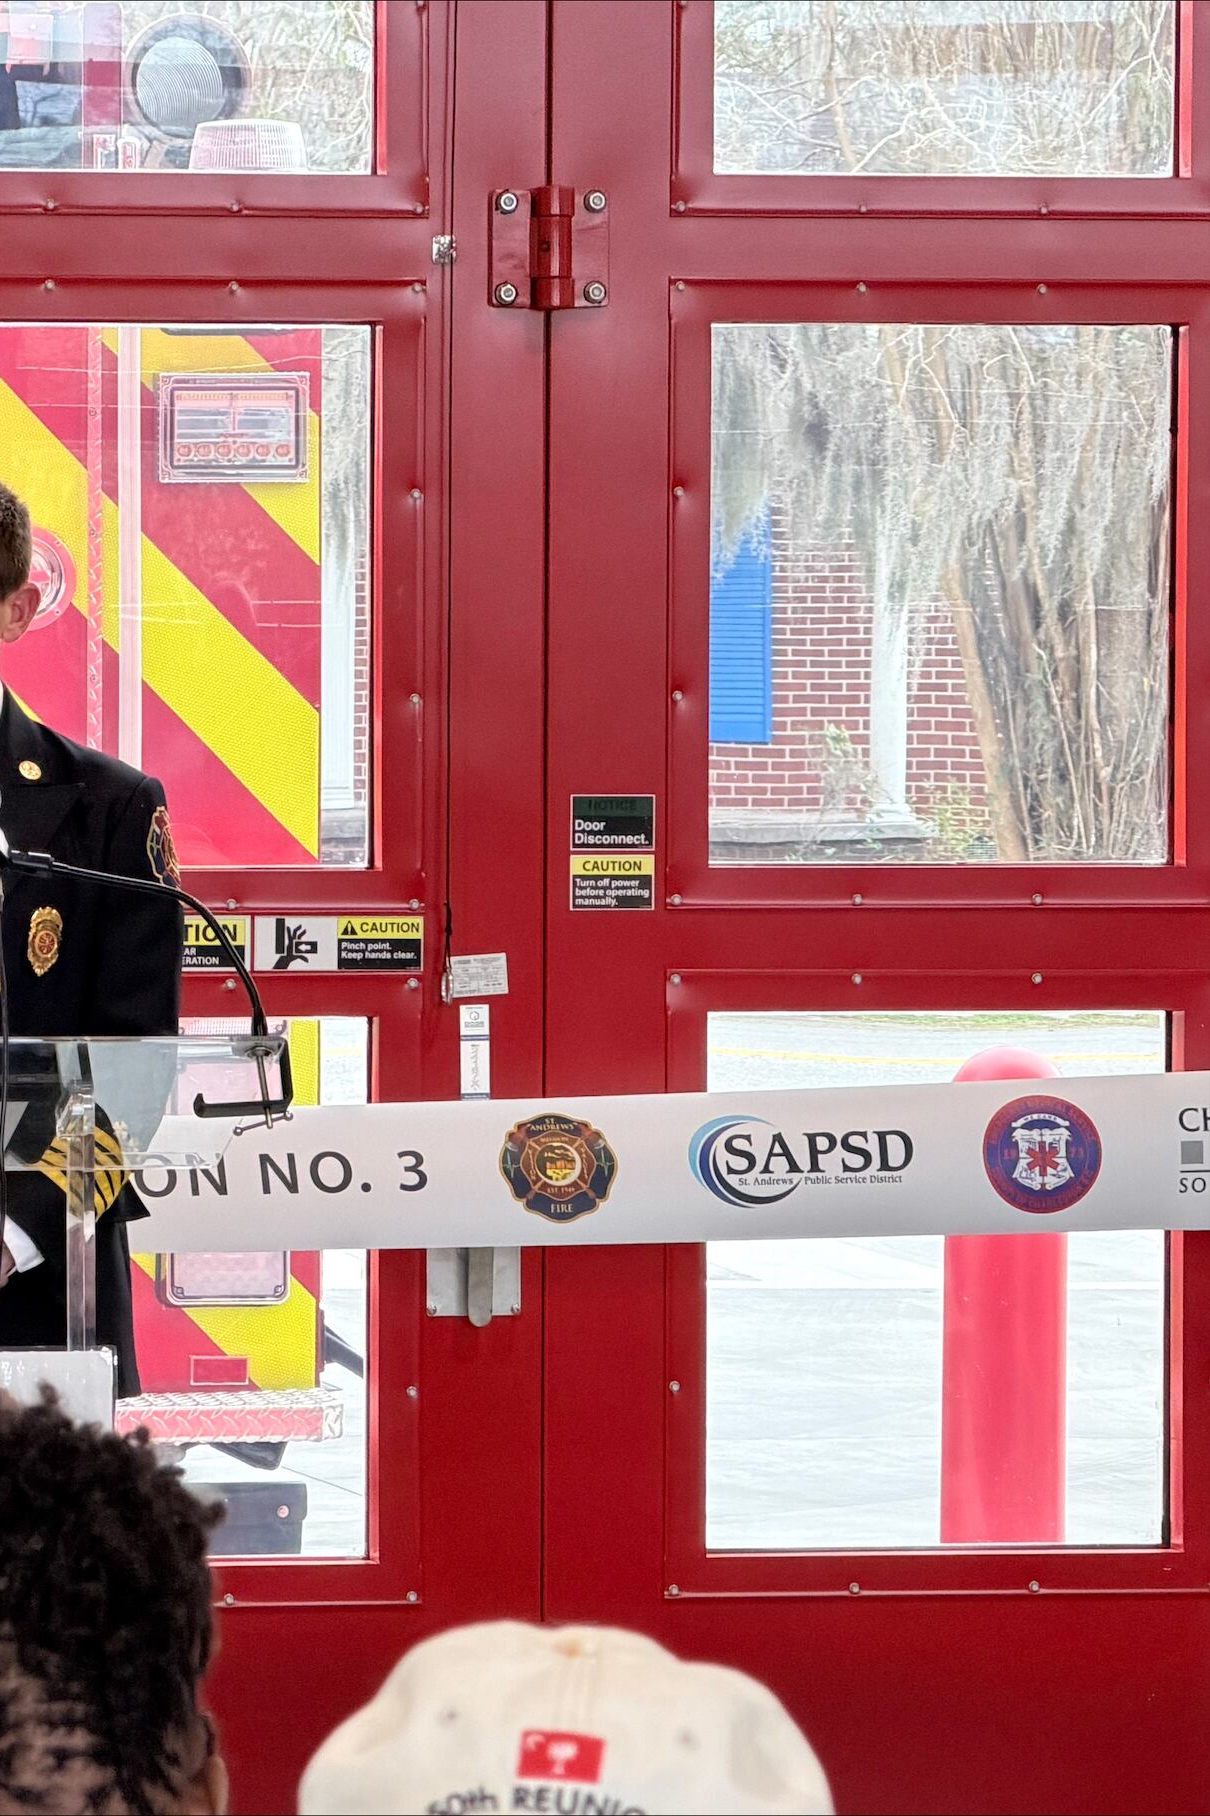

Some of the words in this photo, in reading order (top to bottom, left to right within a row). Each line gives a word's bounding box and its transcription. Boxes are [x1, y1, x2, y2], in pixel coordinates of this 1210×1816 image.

[574, 820, 606, 831] Door
[574, 833, 649, 844] Disconnect.
[582, 860, 642, 872] CAUTION
[575, 878, 596, 887] Turn
[597, 878, 610, 887] off
[611, 879, 639, 889] power
[575, 887, 605, 896] before
[606, 888, 650, 898] operating
[575, 897, 619, 907] manually.
[360, 922, 420, 933] CAUTION
[341, 942, 366, 950] Pinch
[367, 942, 392, 951] point.
[341, 951, 363, 960] Keep
[365, 951, 391, 959] hands
[393, 951, 417, 959] clear.
[529, 1122, 575, 1132] ANDREWS
[724, 1130, 914, 1175] SAPSD
[258, 1151, 372, 1194] NO.
[396, 1150, 428, 1192] 3
[738, 1178, 750, 1186] St.
[753, 1178, 794, 1186] Andrews
[804, 1175, 832, 1185] Public
[835, 1175, 867, 1184] Service
[869, 1174, 903, 1184] District
[550, 1203, 574, 1214] FIRE
